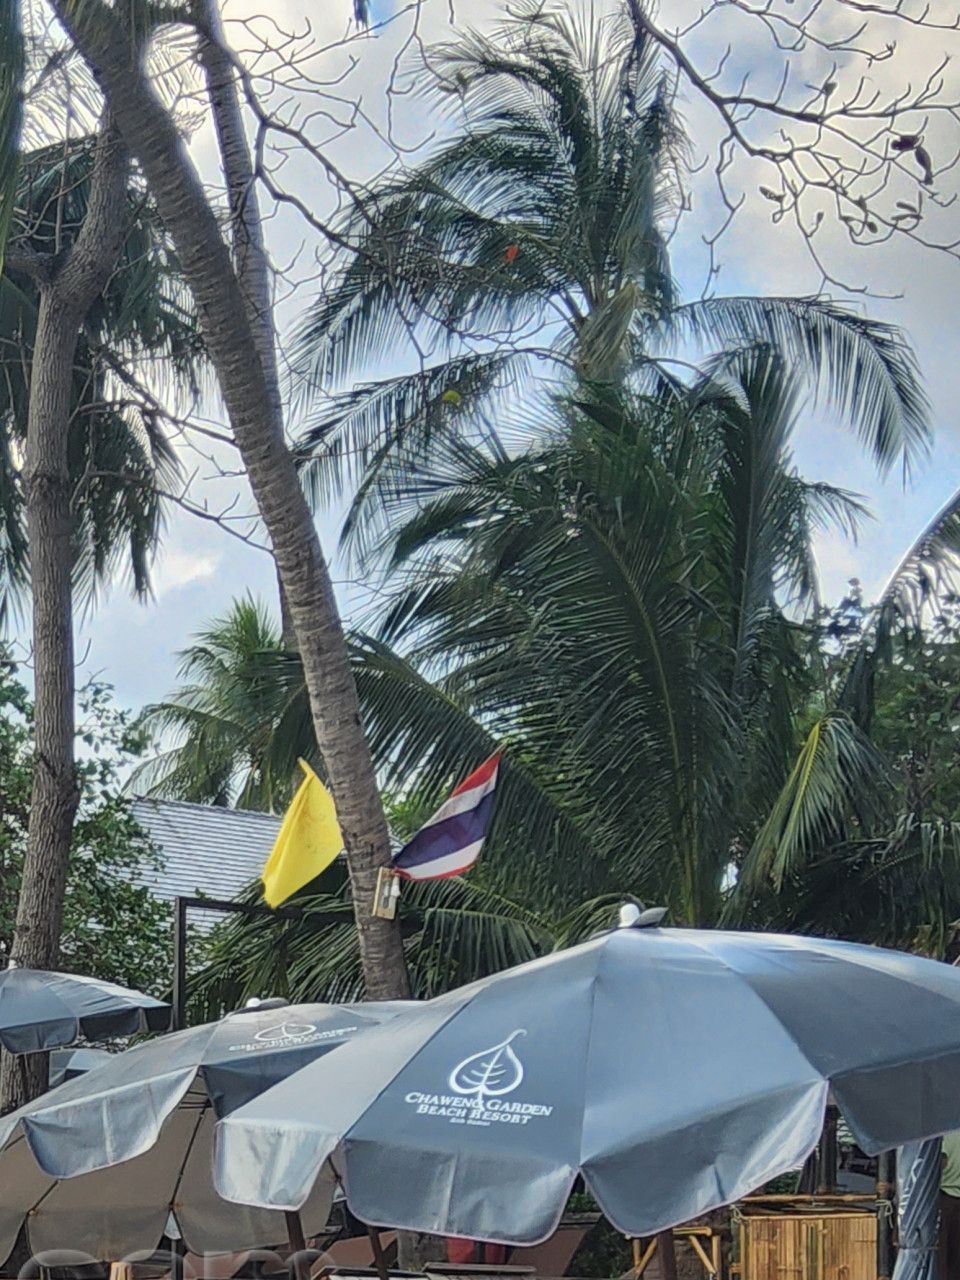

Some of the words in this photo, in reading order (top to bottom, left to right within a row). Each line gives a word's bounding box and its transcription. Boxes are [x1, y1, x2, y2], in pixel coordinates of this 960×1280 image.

[405, 1092, 483, 1109] CHAWENG
[487, 1099, 553, 1116] GARDEN
[416, 1104, 466, 1117] BEACH
[469, 1109, 532, 1124] RESORT
